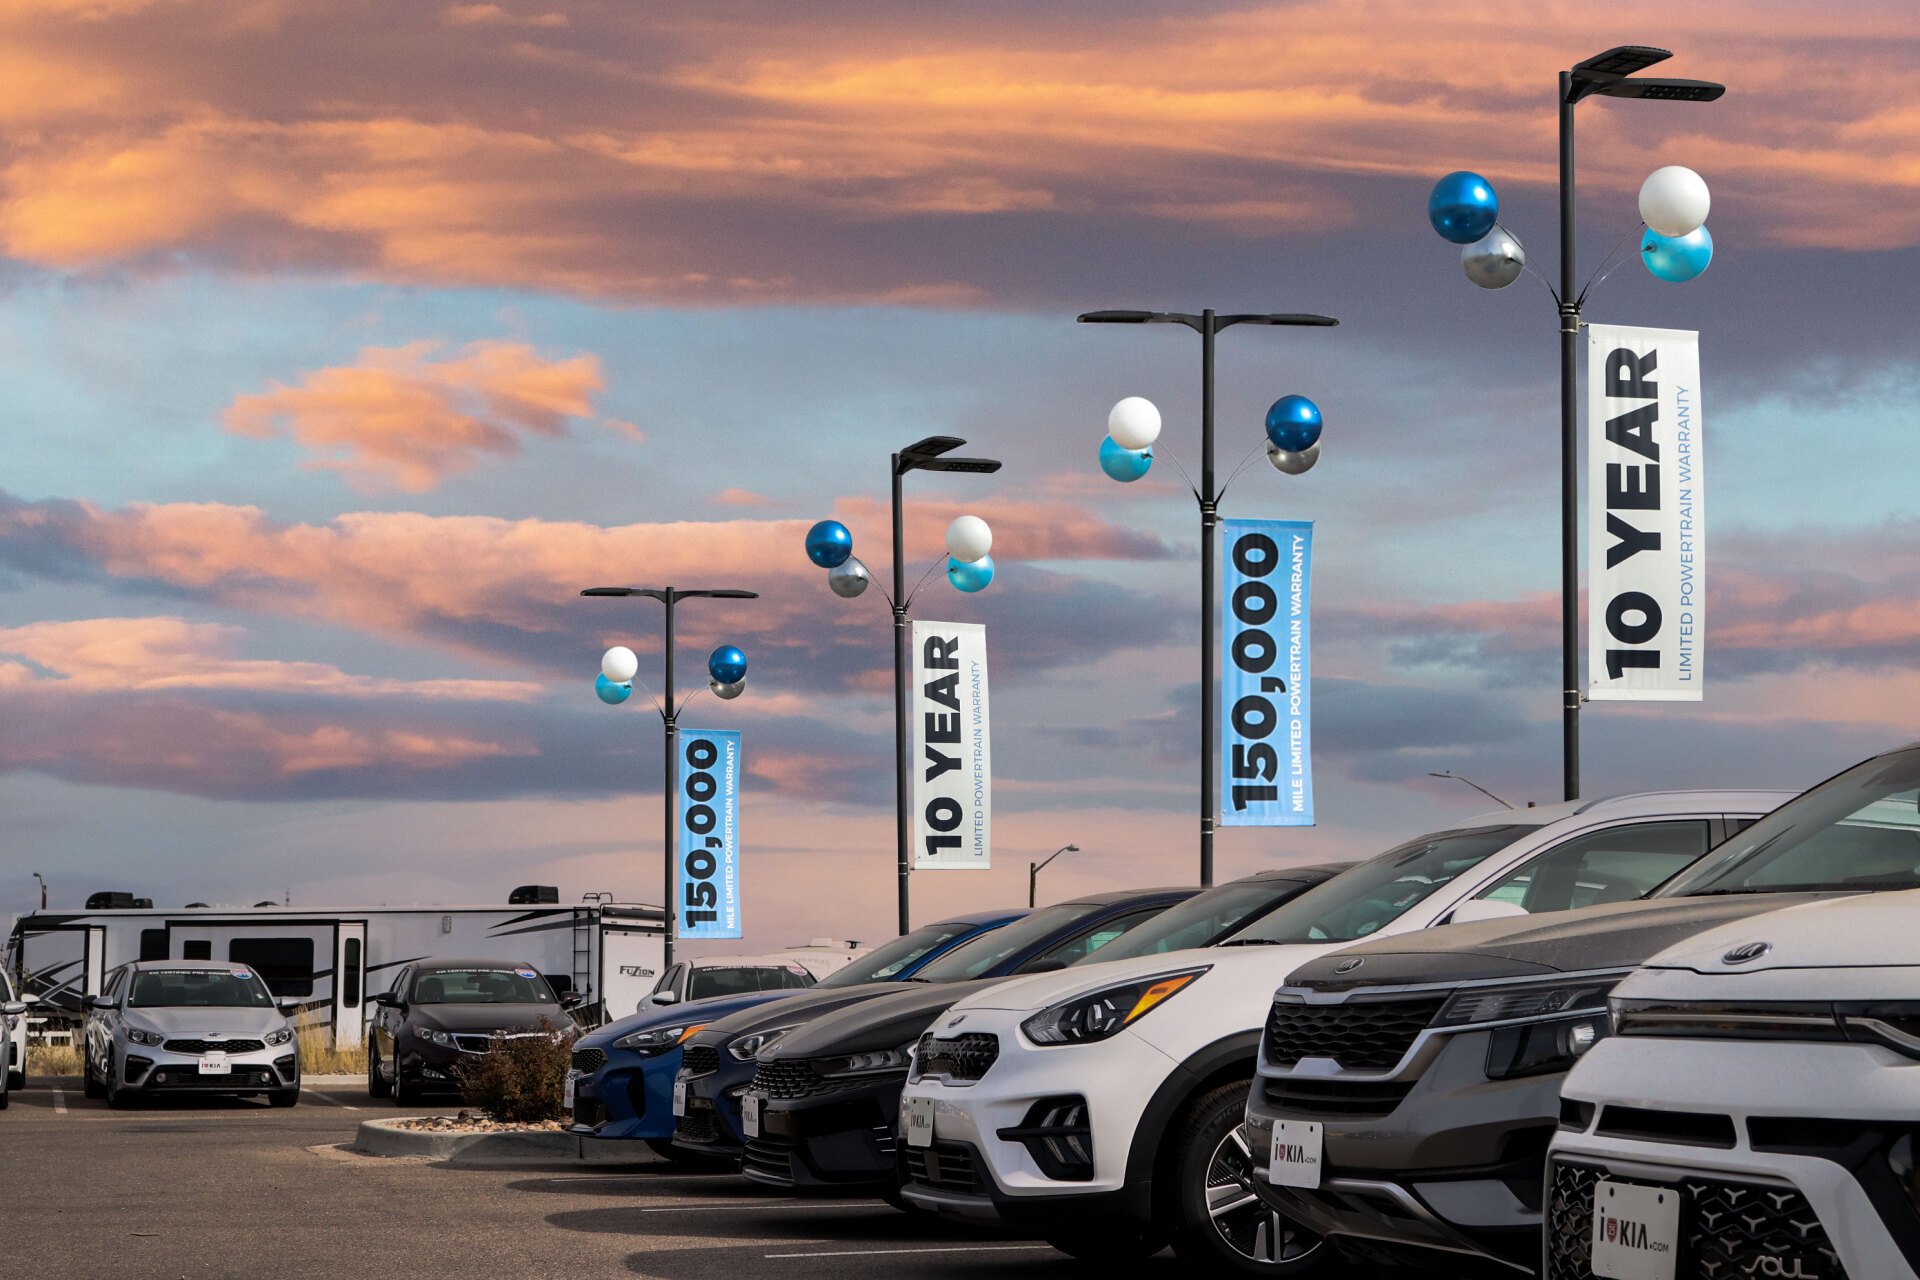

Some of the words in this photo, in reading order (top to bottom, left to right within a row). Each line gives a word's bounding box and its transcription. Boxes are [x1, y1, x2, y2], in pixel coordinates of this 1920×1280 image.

[1605, 347, 1661, 570] YEAR
[1676, 385, 1692, 487] WARRANTY
[1291, 535, 1304, 617] WARRANTY
[1678, 488, 1693, 607] POWERTRAIN
[1289, 620, 1302, 717] POWERTRAIN
[1605, 591, 1662, 680] 10
[1678, 612, 1693, 681] LIMITED
[971, 660, 982, 724] WARRANTY
[1231, 532, 1286, 812] 150,000
[924, 635, 962, 783] YEAR
[726, 740, 735, 796] WARRANTY
[973, 728, 983, 807] POWERTRAIN
[1290, 721, 1303, 776] LIMITED
[925, 797, 963, 856] 10
[1291, 779, 1304, 812] MILE
[685, 738, 723, 928] 150,000
[725, 799, 734, 864] POWERTRAIN
[974, 812, 983, 856] LIMITED
[726, 867, 734, 904] LIMITED
[726, 906, 735, 929] MILE
[1740, 1255, 1819, 1280] SOUL
